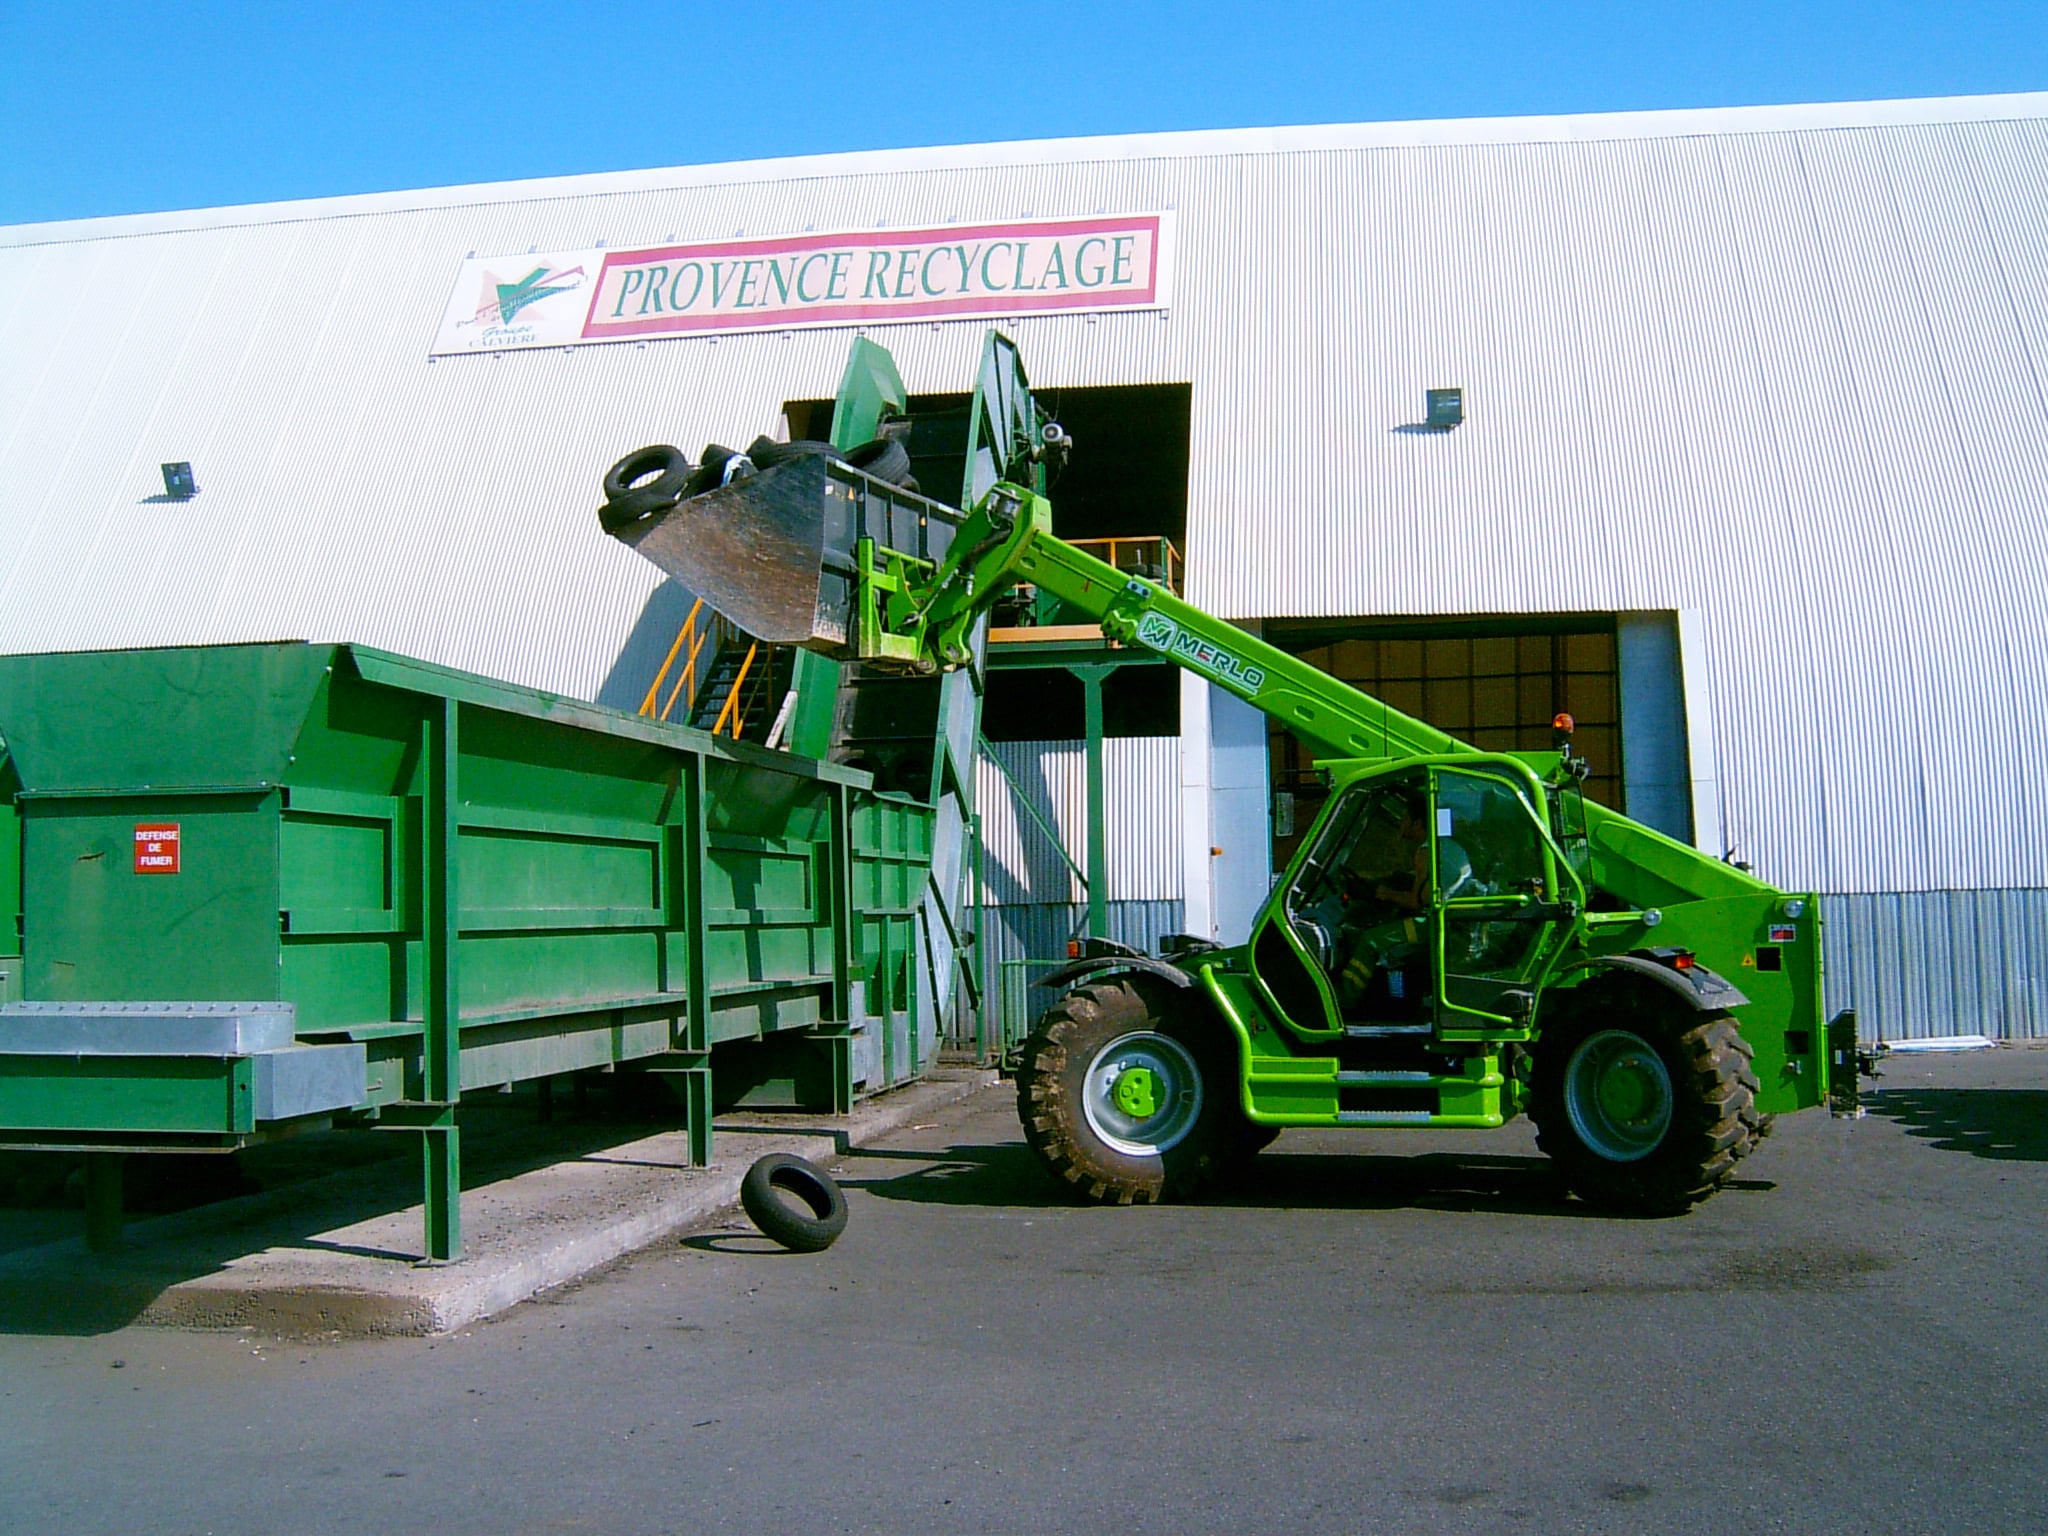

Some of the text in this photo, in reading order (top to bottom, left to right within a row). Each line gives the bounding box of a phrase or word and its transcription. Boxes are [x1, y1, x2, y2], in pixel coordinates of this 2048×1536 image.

[611, 251, 853, 318] PROVENCE
[860, 235, 1135, 299] RECYCLAGE
[1175, 630, 1264, 688] MERLO
[135, 831, 179, 841] DEFENSE
[148, 843, 162, 853] DE
[140, 856, 173, 866] FUMER
